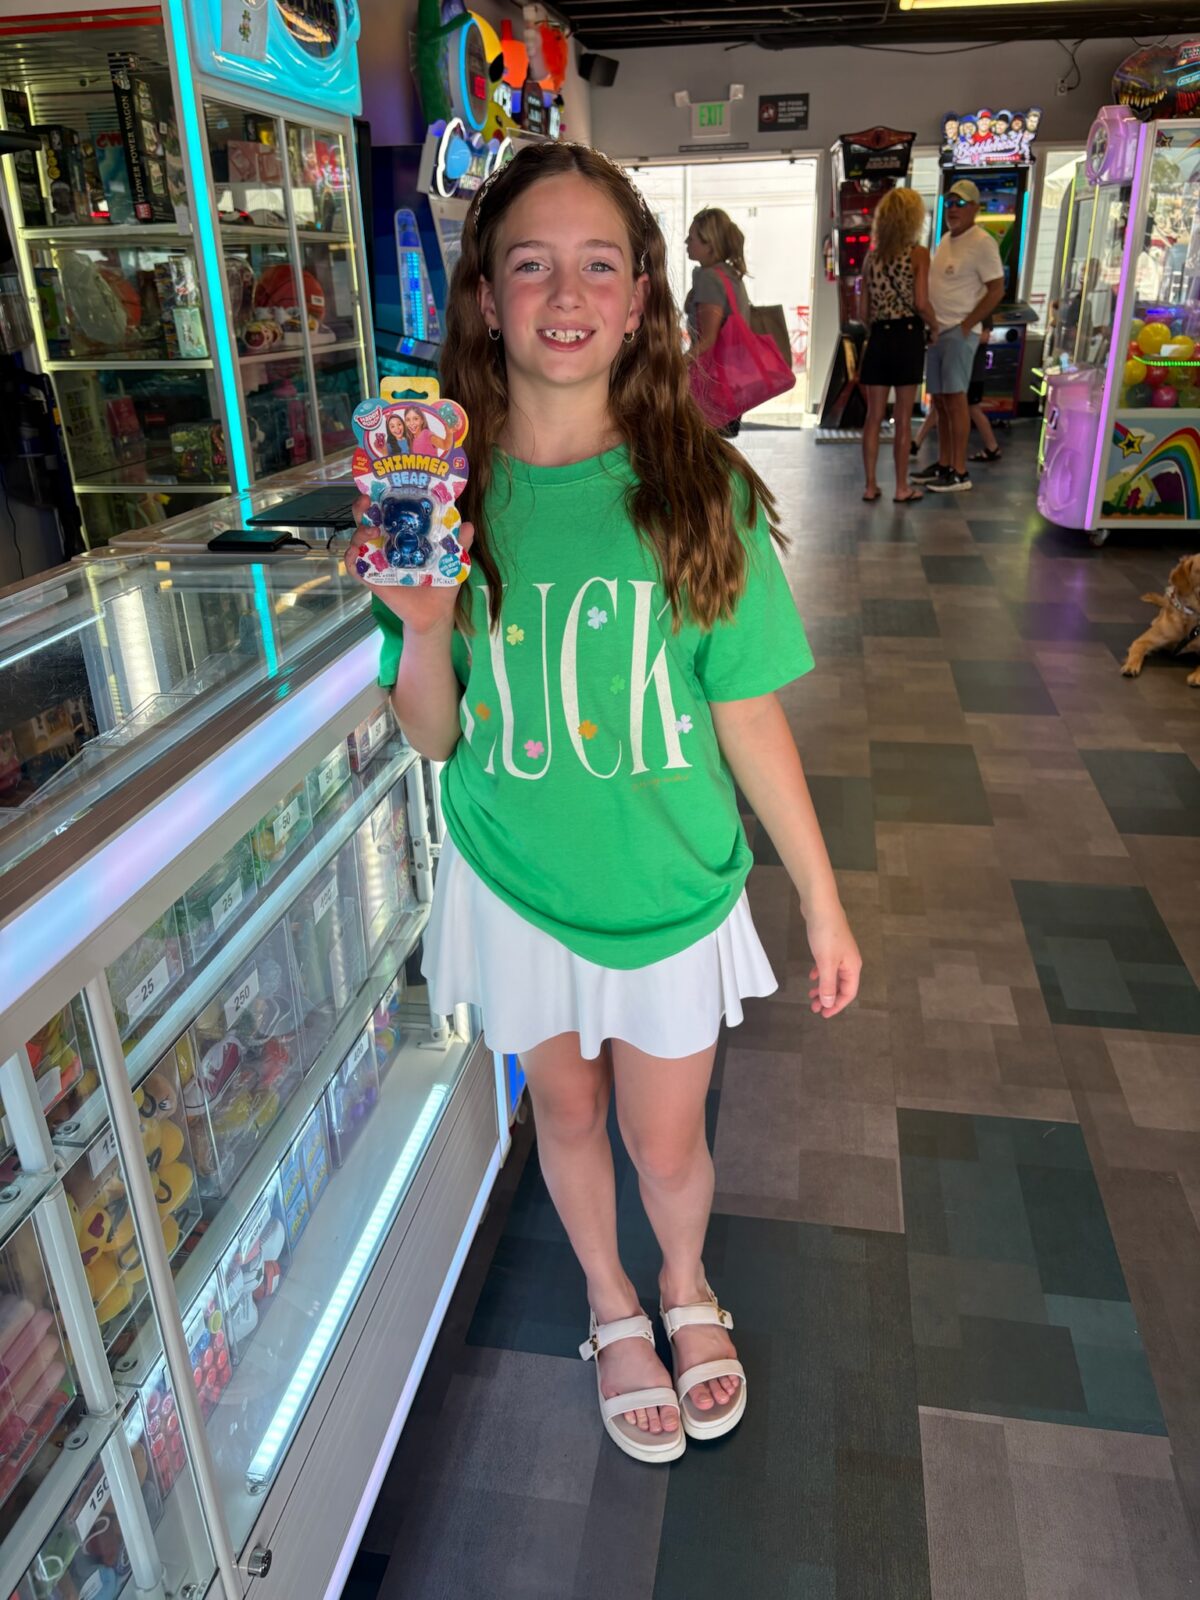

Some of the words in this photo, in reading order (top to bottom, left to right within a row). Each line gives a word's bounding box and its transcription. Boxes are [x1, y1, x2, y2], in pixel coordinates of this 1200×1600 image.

[121, 95, 133, 130] WAGON
[698, 103, 724, 127] EXIT
[127, 131, 138, 164] POWER
[373, 454, 450, 478] SHIMMER
[391, 472, 429, 487] BEAR
[282, 811, 291, 829] 50
[222, 892, 233, 914] 25
[140, 978, 154, 1002] 25
[233, 984, 250, 1013] 250
